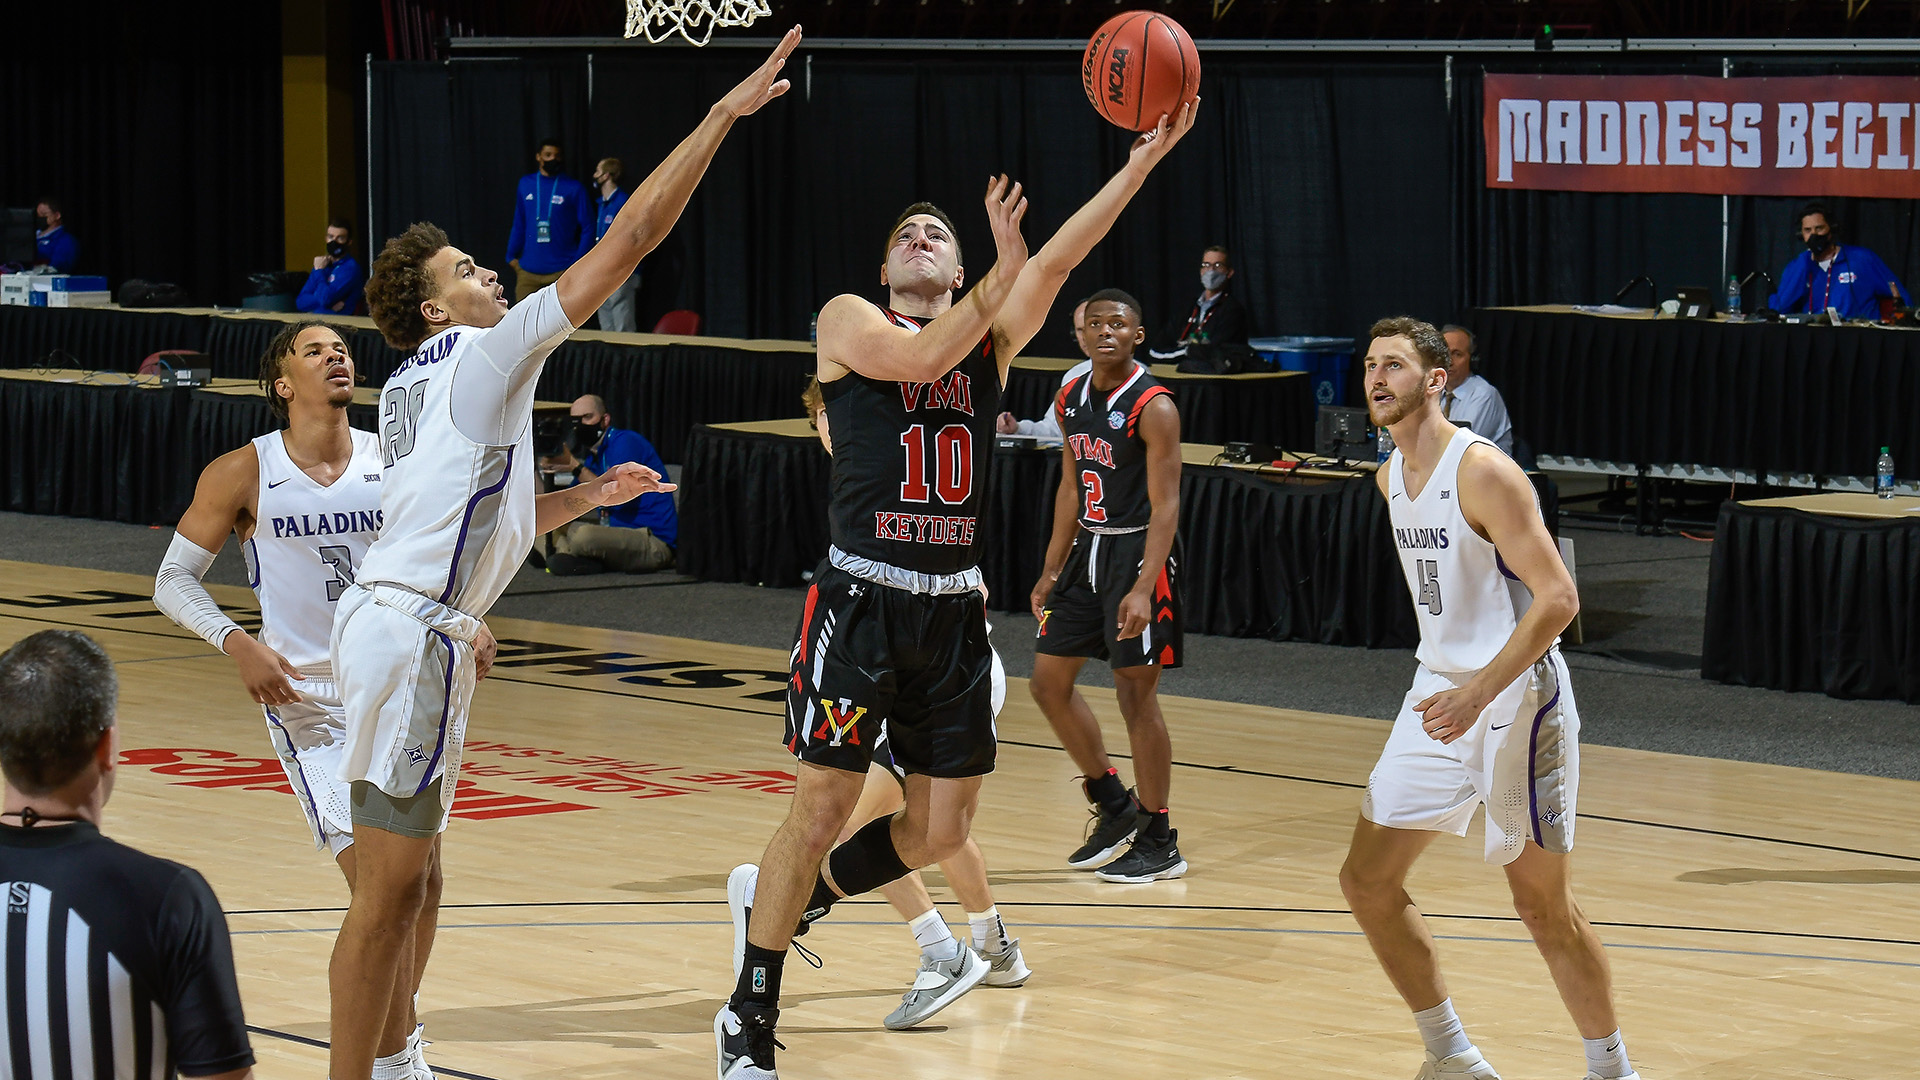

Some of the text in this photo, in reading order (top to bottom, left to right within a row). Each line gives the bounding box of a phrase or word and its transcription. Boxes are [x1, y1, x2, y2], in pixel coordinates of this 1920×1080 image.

[1108, 48, 1129, 106] NCAA
[1497, 99, 1920, 182] MADNESS BEGI
[898, 370, 975, 417] VMI
[383, 378, 430, 470] 20
[1068, 433, 1116, 470] VMI
[900, 423, 973, 505] 10
[271, 508, 384, 539] PALADINS
[1081, 469, 1109, 523] 2
[1395, 527, 1450, 550] PALADINS
[318, 545, 355, 602] 3
